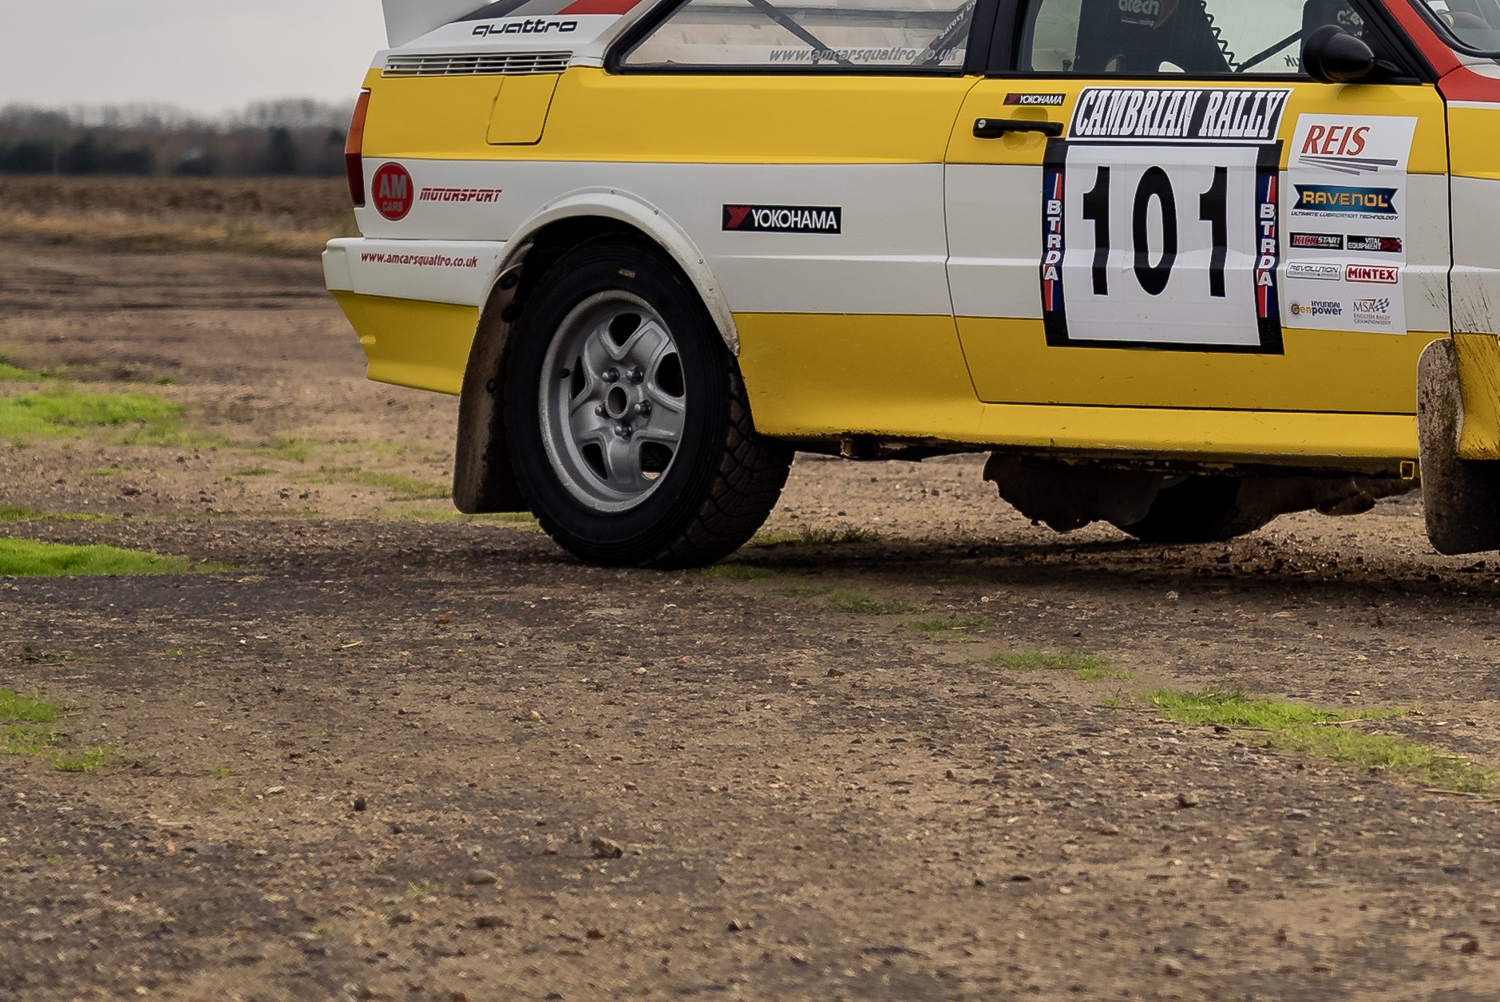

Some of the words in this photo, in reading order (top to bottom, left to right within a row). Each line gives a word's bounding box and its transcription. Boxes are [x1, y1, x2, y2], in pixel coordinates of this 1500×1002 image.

[472, 18, 578, 38] quattro
[1020, 94, 1063, 105] YOKOHAMA
[1075, 90, 1201, 136] CAMBRIAN
[1198, 90, 1285, 138] RALLY
[1301, 124, 1371, 156] REIS
[379, 173, 407, 200] AM
[419, 187, 503, 203] MOTORSPORT
[382, 200, 404, 213] CARS
[1302, 190, 1389, 208] RAVENOL
[752, 208, 838, 230] YOKOHAMA
[1044, 199, 1062, 281] BTRDA
[1082, 165, 1228, 298] 101
[1258, 203, 1277, 287] BTRDA
[361, 252, 479, 268] www.amcarsquattro.co.uk
[1347, 267, 1395, 281] MINTEX
[1353, 301, 1376, 313] MSA
